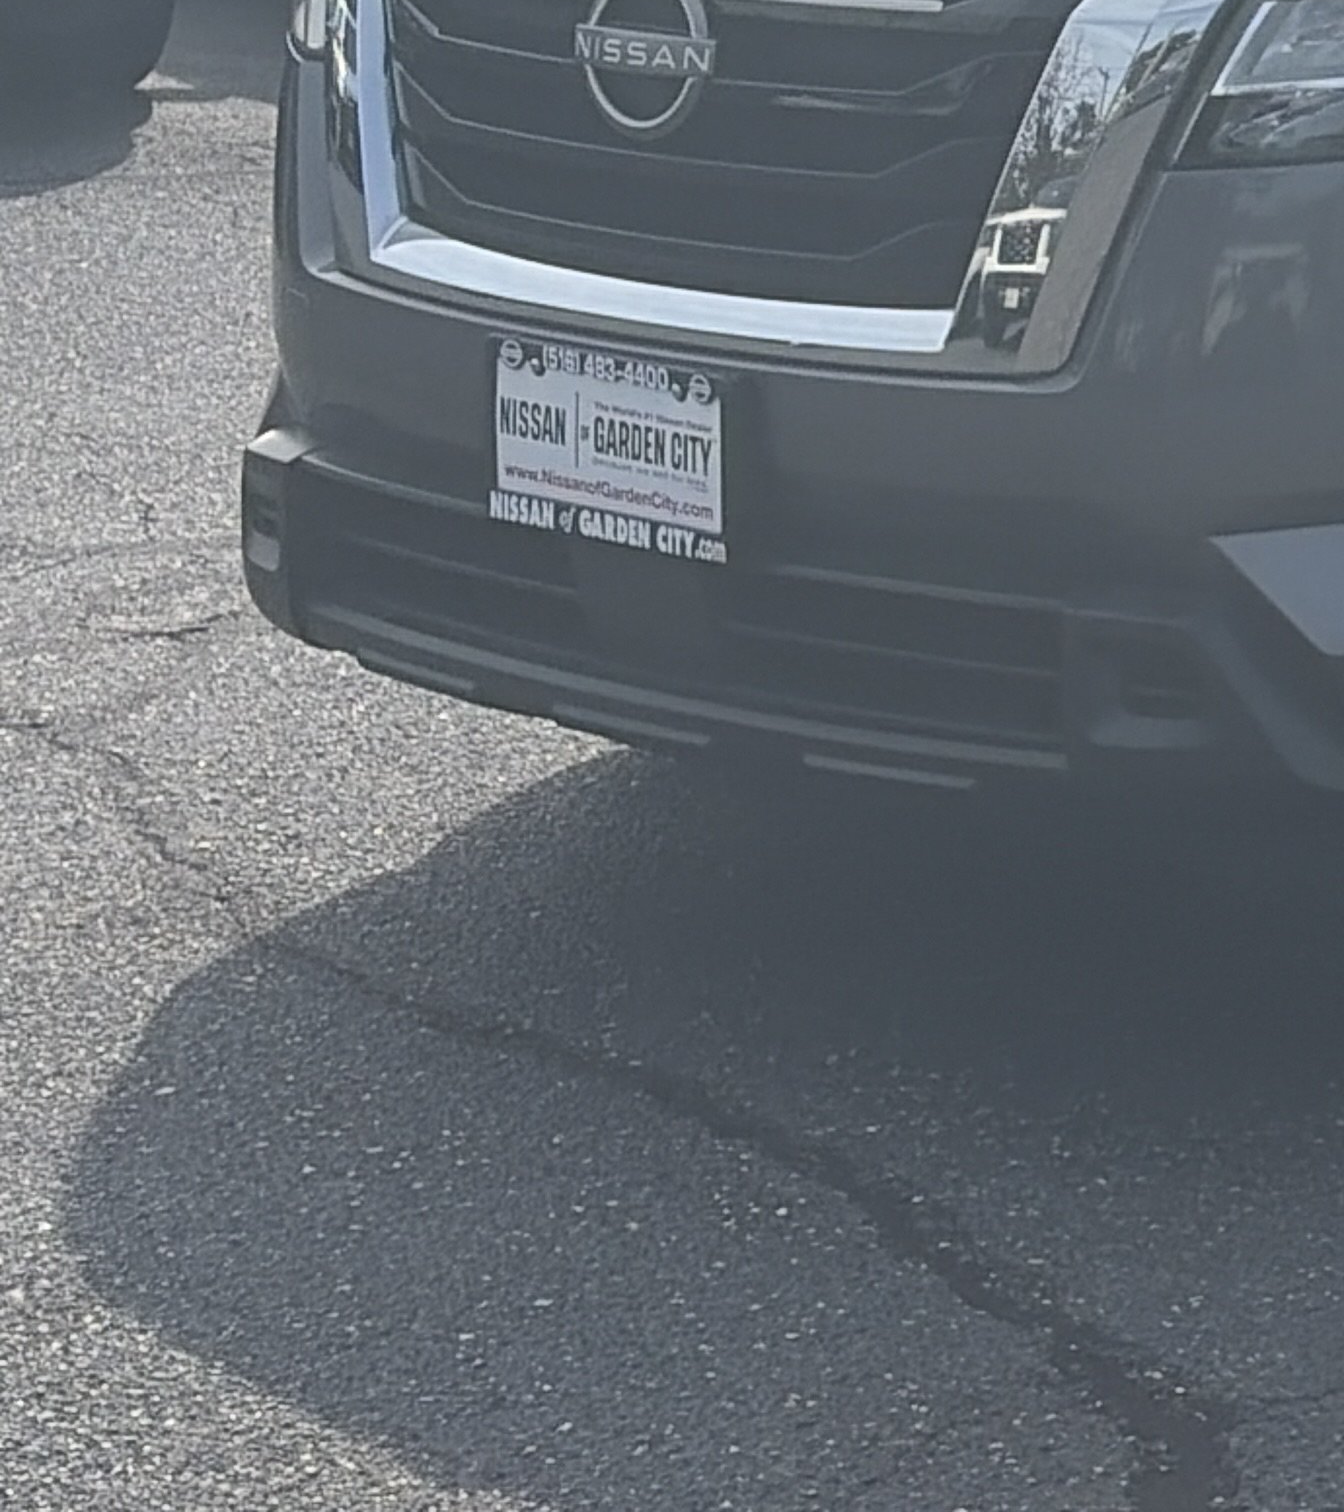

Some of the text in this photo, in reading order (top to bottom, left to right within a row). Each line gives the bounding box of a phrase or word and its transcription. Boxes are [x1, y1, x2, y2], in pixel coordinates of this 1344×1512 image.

[574, 31, 711, 72] NISSAN
[500, 396, 567, 447] NISSAN
[594, 415, 666, 467] GARDEN
[671, 431, 712, 477] CITY
[489, 489, 556, 530] NISSAN
[558, 506, 577, 534] of
[578, 508, 652, 550] GARDEN
